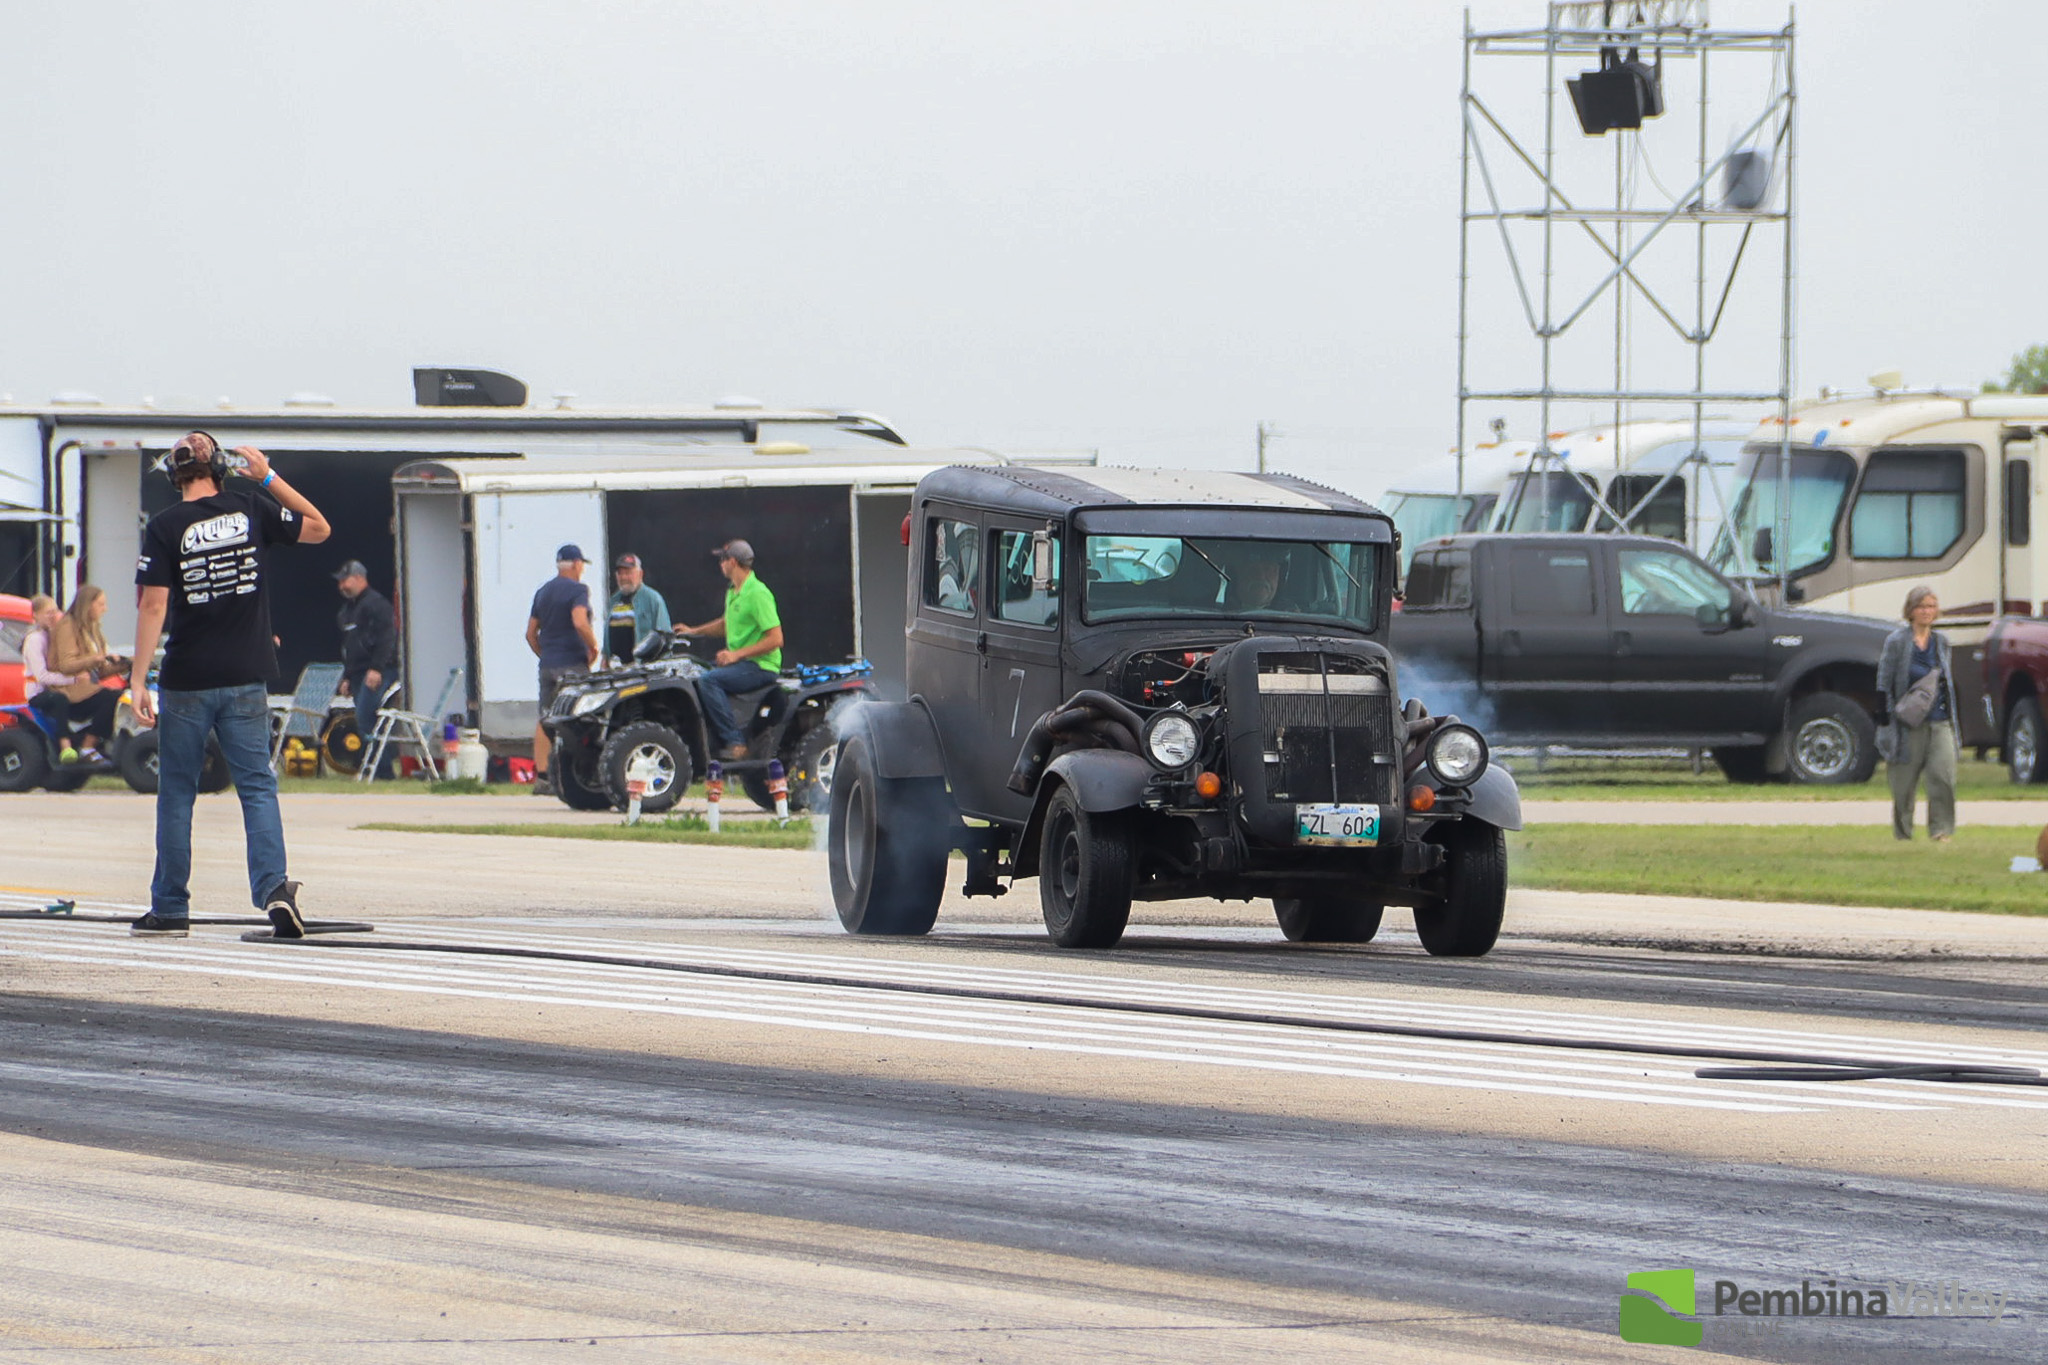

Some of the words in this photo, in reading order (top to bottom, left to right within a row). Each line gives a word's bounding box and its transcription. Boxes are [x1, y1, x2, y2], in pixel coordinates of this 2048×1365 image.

[1008, 668, 1025, 738] 7
[1298, 813, 1330, 835] FZL
[1343, 816, 1375, 836] 603
